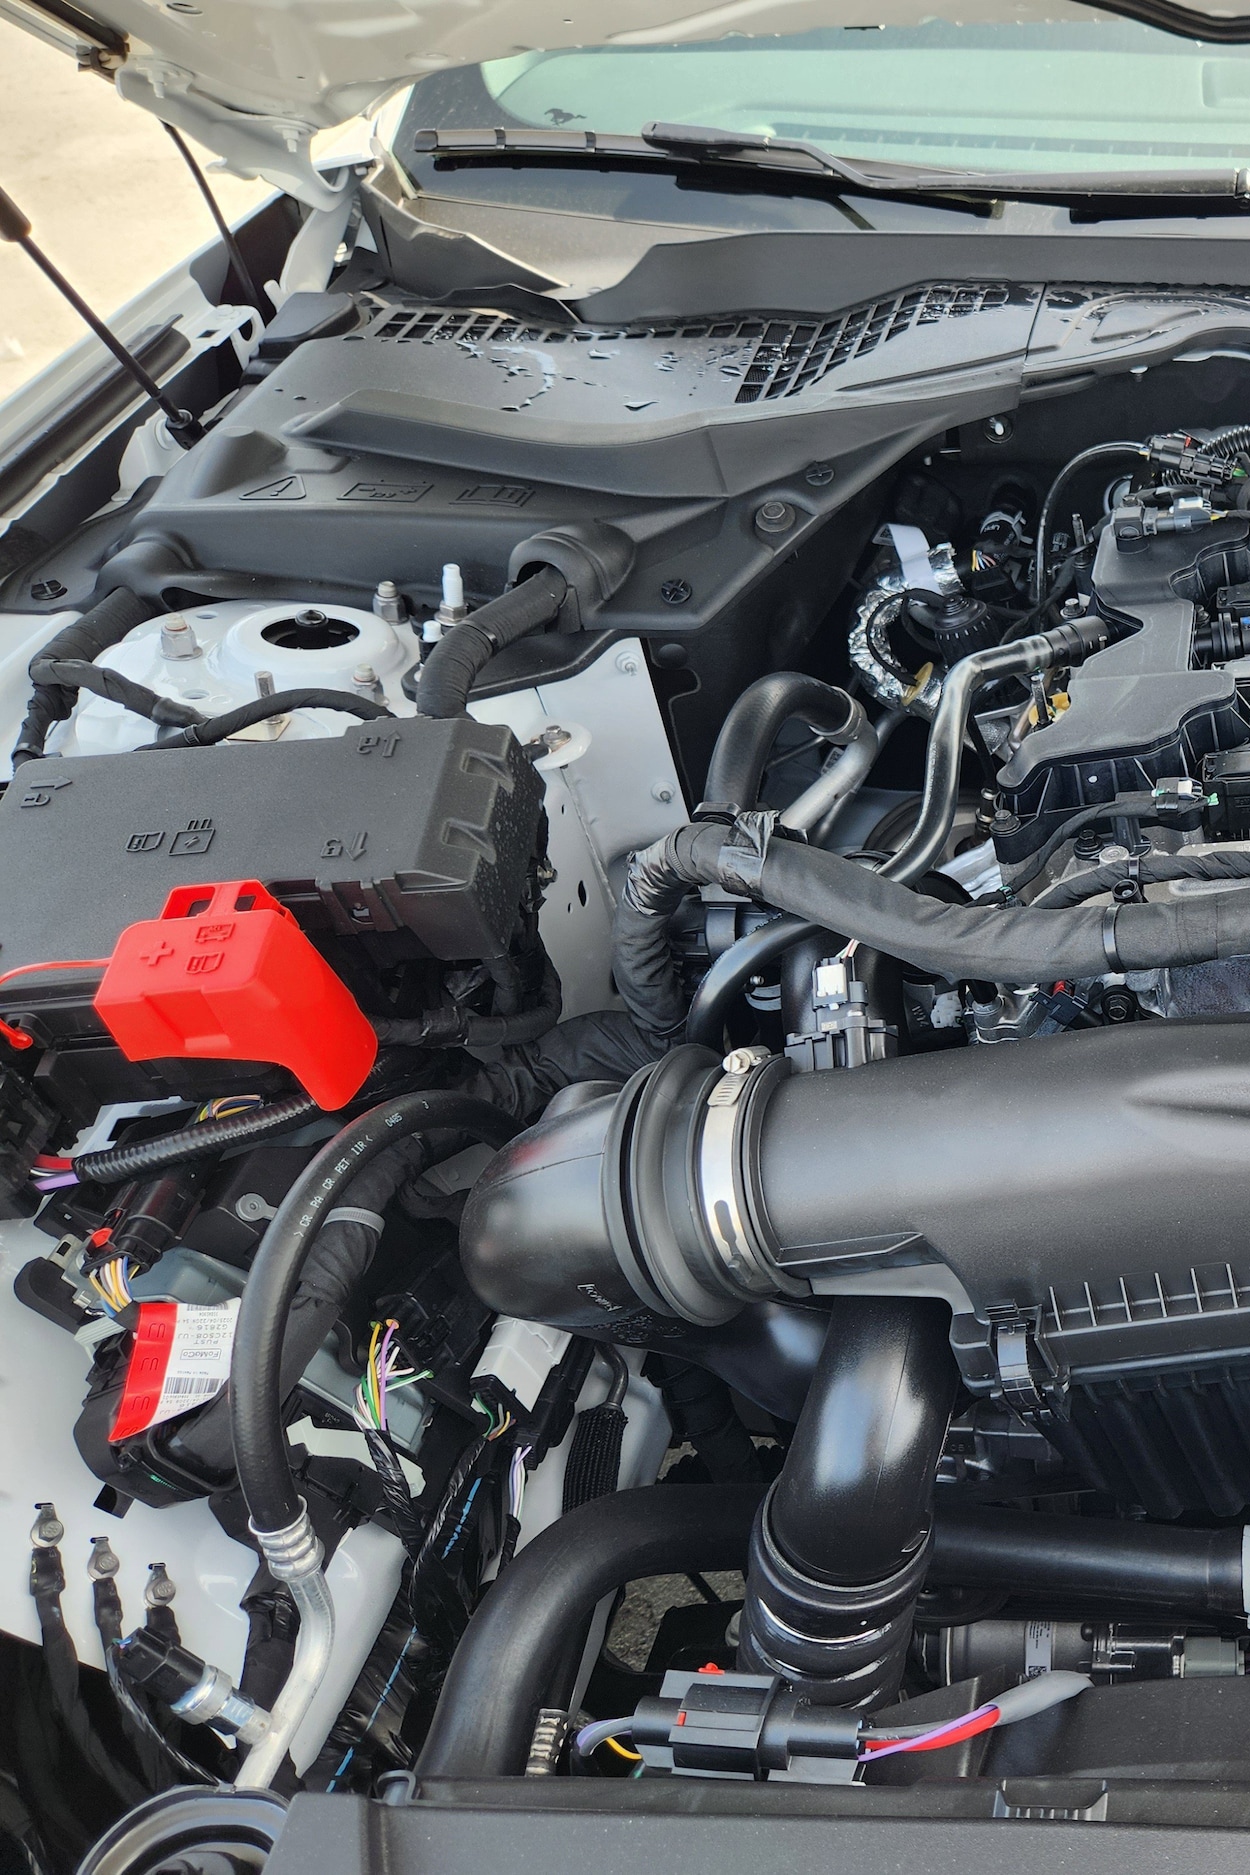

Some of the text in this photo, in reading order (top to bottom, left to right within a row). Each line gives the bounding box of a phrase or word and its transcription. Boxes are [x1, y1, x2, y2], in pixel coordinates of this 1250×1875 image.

[299, 1213, 314, 1228] CR
[310, 1195, 325, 1209] PA
[322, 1177, 336, 1190] CR
[334, 1157, 351, 1175] PET
[182, 1350, 220, 1359] FoMoCo
[139, 1357, 160, 1371] UJ
[130, 1395, 151, 1411] UJ
